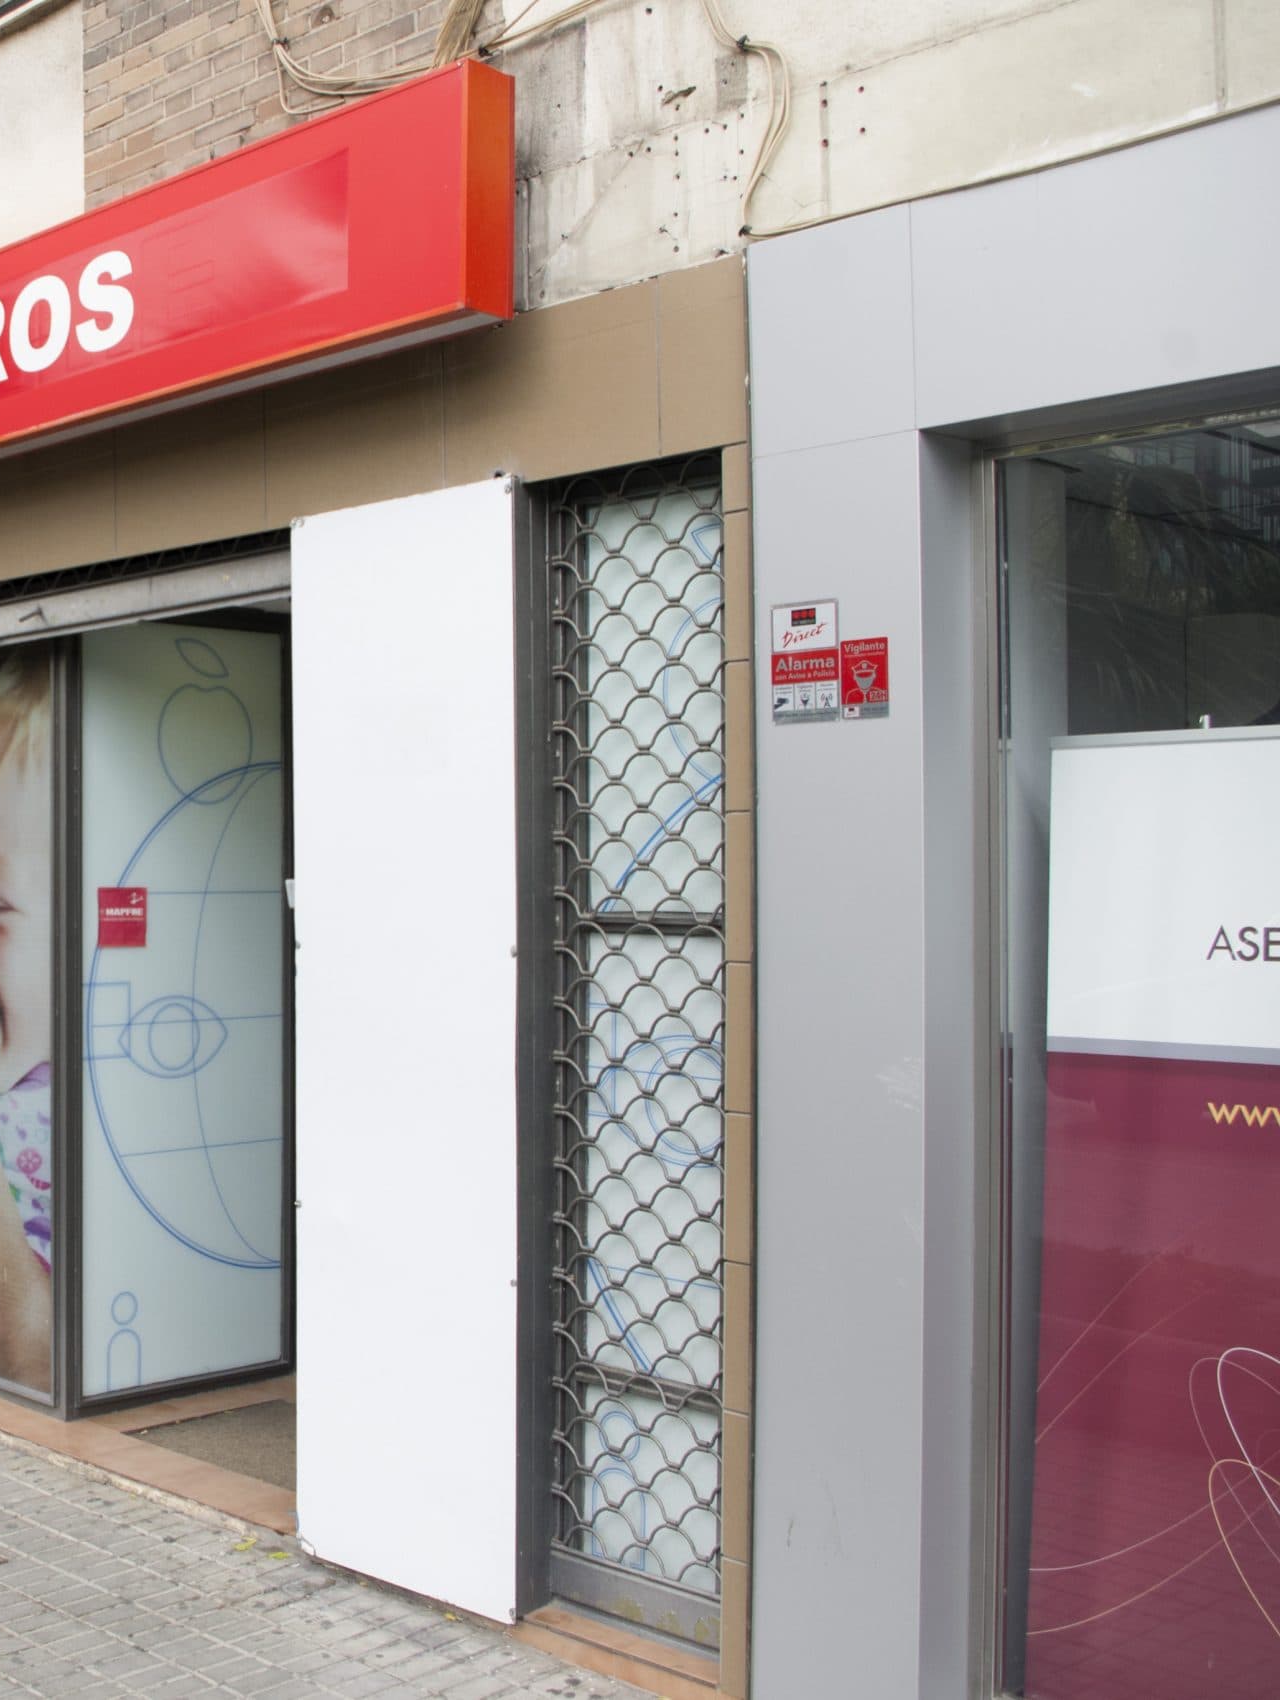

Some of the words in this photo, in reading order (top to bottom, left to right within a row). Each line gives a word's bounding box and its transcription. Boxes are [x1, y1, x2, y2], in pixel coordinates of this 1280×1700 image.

[782, 621, 827, 648] Direct
[844, 642, 886, 655] Vigilante
[776, 657, 836, 672] Alarma
[105, 908, 144, 916] MAPFRE
[1206, 925, 1280, 961] ASE
